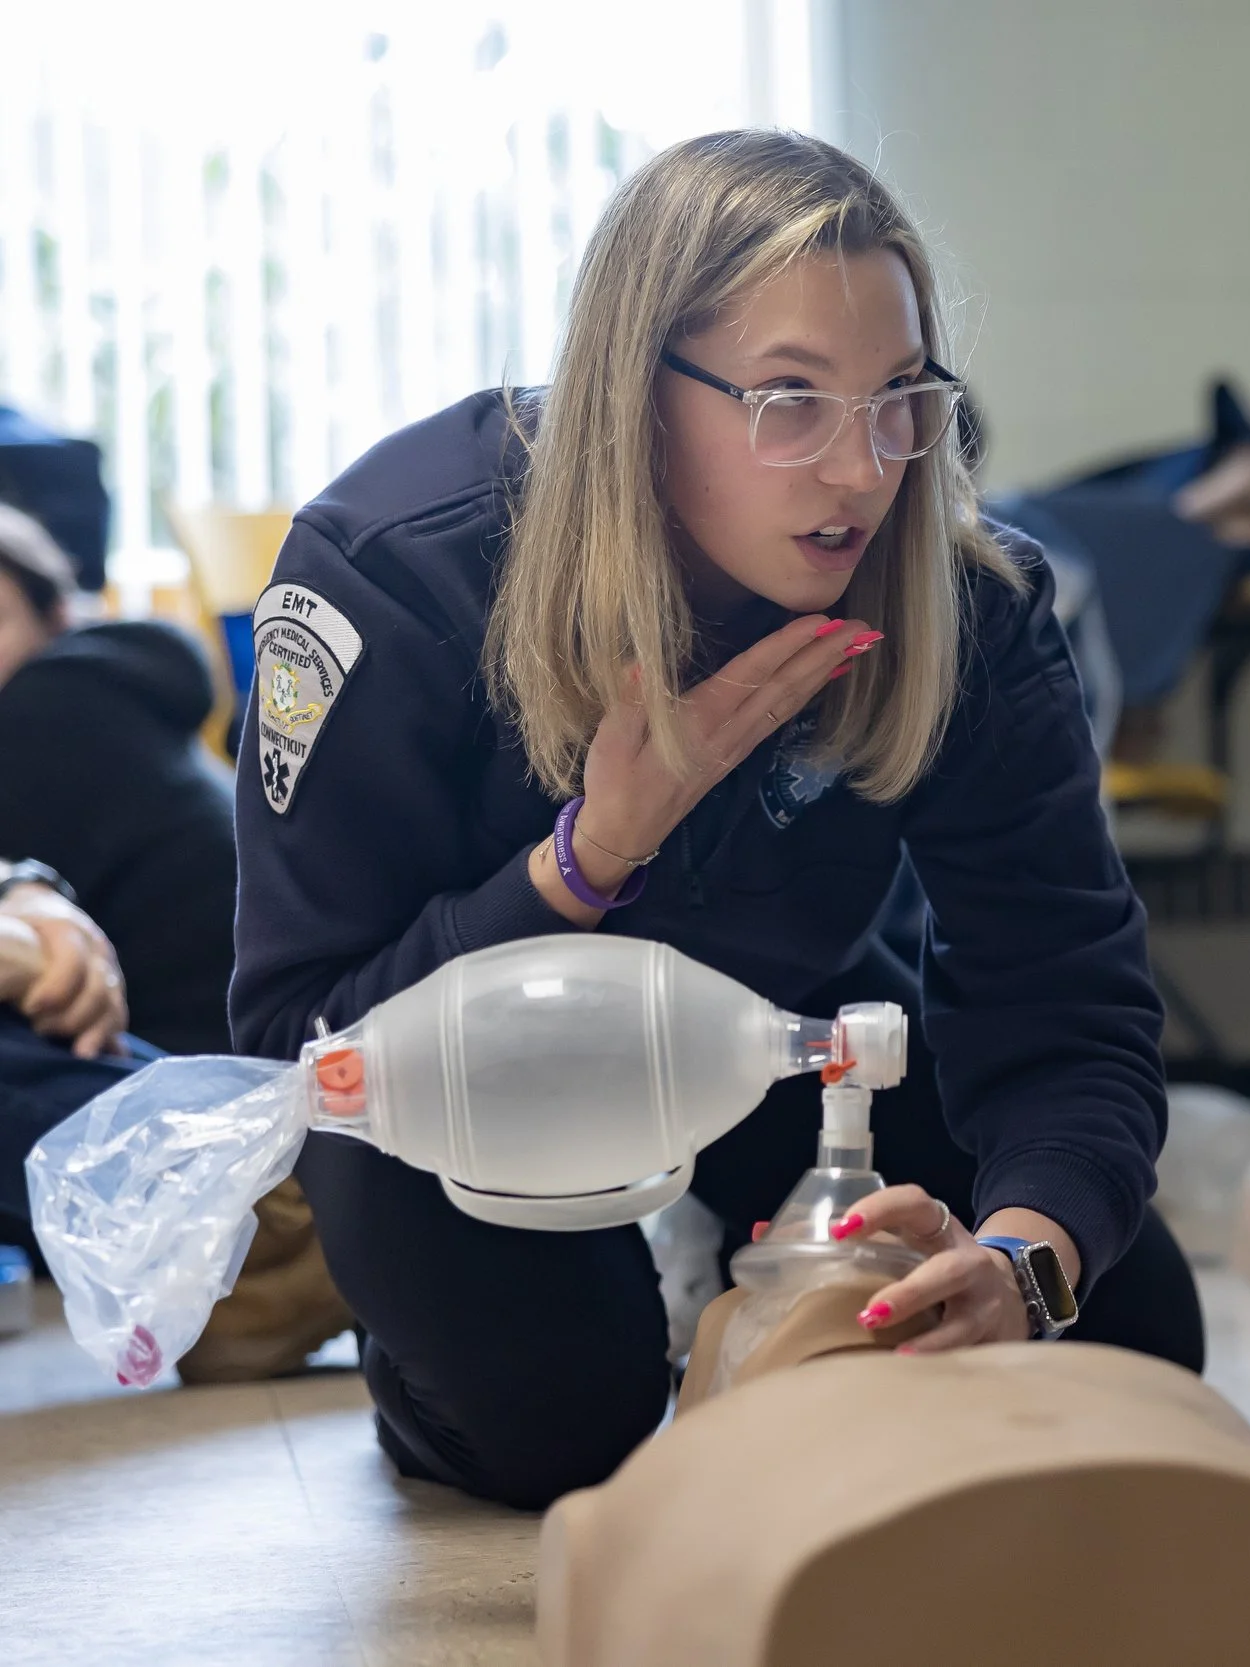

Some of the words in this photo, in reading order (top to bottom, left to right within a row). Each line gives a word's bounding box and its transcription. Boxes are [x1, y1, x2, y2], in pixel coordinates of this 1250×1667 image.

[282, 591, 318, 618] EMT
[268, 641, 311, 669] CERTIFIED
[281, 628, 310, 652] MEDICAL
[309, 649, 334, 697] SERVICES
[261, 721, 307, 758] CONNECTICUT
[557, 814, 569, 864] Awareness
